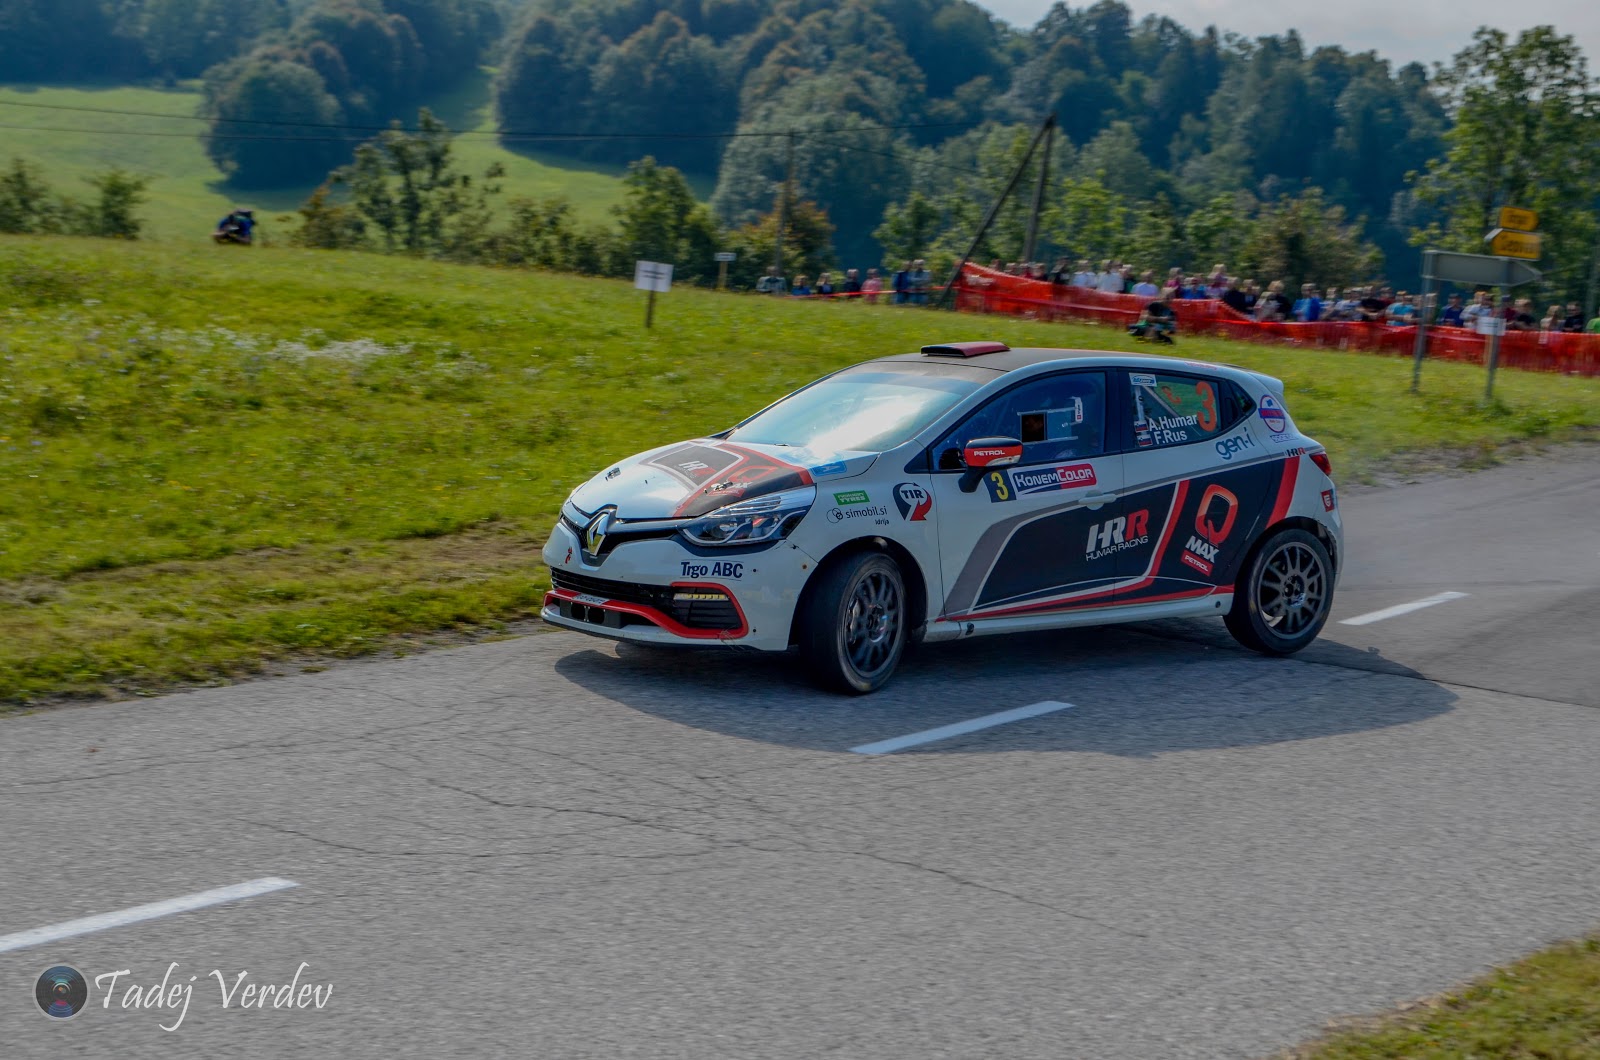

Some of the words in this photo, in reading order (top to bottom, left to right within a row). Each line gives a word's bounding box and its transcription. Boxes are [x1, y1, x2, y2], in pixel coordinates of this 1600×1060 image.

[1195, 381, 1217, 432] 3
[1149, 414, 1198, 432] A.Humar
[1154, 428, 1188, 445] F.Rus
[1286, 447, 1306, 457] HRR
[901, 489, 925, 499] TIR
[991, 471, 1009, 500] 3
[845, 505, 888, 518] simobil.si
[1195, 484, 1239, 548] Q
[1085, 508, 1149, 553] HRR
[1085, 545, 1118, 562] HUMAR
[1117, 536, 1149, 552] RACING
[1185, 535, 1220, 563] MAX
[680, 561, 709, 579] Trgo
[711, 562, 744, 579] ABC
[1184, 554, 1209, 572] PETROL
